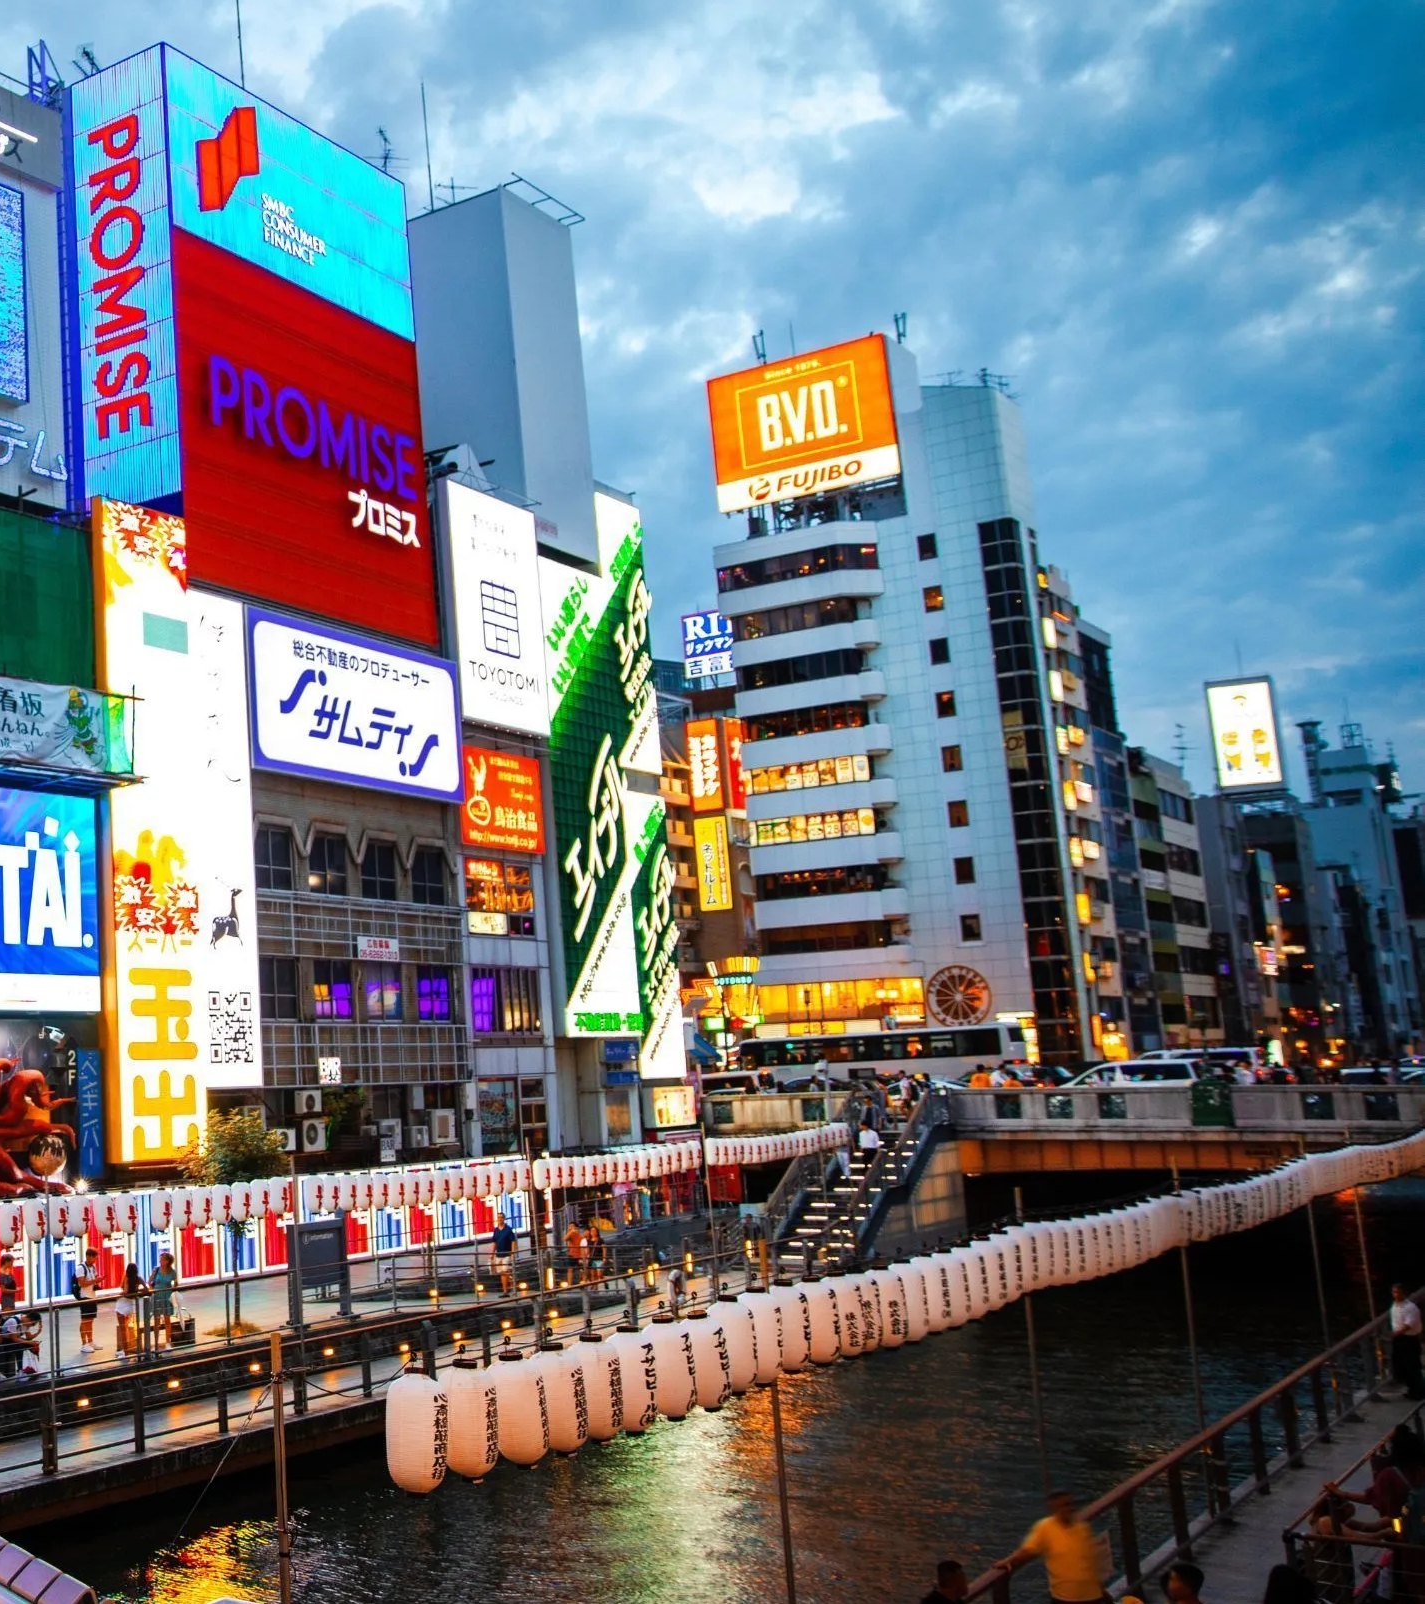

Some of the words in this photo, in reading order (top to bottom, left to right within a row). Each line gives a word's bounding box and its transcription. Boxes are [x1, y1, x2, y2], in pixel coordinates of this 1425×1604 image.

[261, 192, 295, 223] SMBC
[262, 210, 327, 257] CONSUMER
[88, 113, 152, 440] PROMISE
[263, 226, 316, 267] FINANCE
[208, 354, 419, 502] PROMISE
[756, 379, 850, 453] B.V.D.
[776, 459, 863, 493] FUJIBO
[348, 488, 421, 549] プロミス
[613, 567, 653, 683] エイブル
[292, 638, 430, 685] 総合不動産のプロデューサー
[469, 660, 540, 694] TOYOTOMI
[309, 694, 414, 755] サムティ
[564, 733, 626, 943] エイブル
[701, 843, 717, 905] ネットルーム
[128, 967, 199, 1162] 玉出
[680, 1331, 699, 1412] アサヒビール(
[712, 1326, 732, 1405] アサヒビール(
